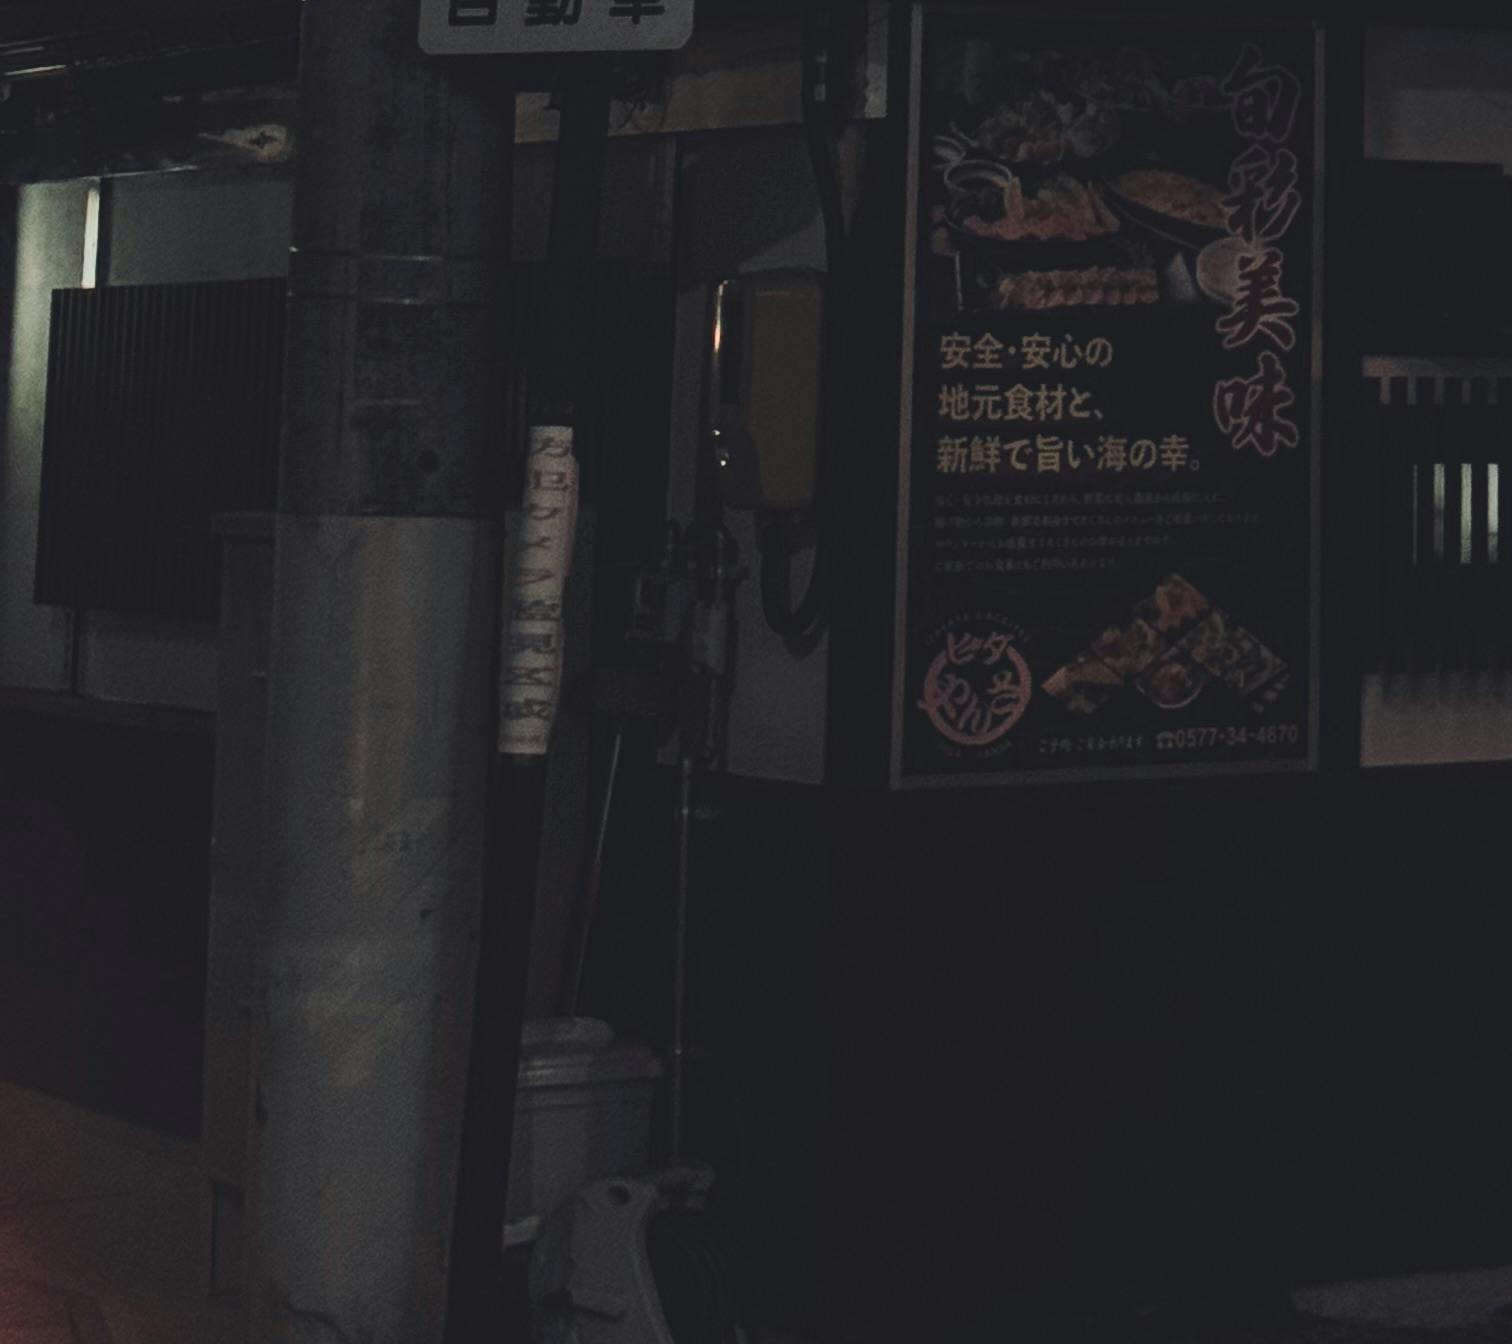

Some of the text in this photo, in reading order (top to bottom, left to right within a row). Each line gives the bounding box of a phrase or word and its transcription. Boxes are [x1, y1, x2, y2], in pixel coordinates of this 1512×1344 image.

[937, 383, 1104, 422] 地元食材と、
[936, 433, 1200, 474] 新鮮で旨い海の幸。
